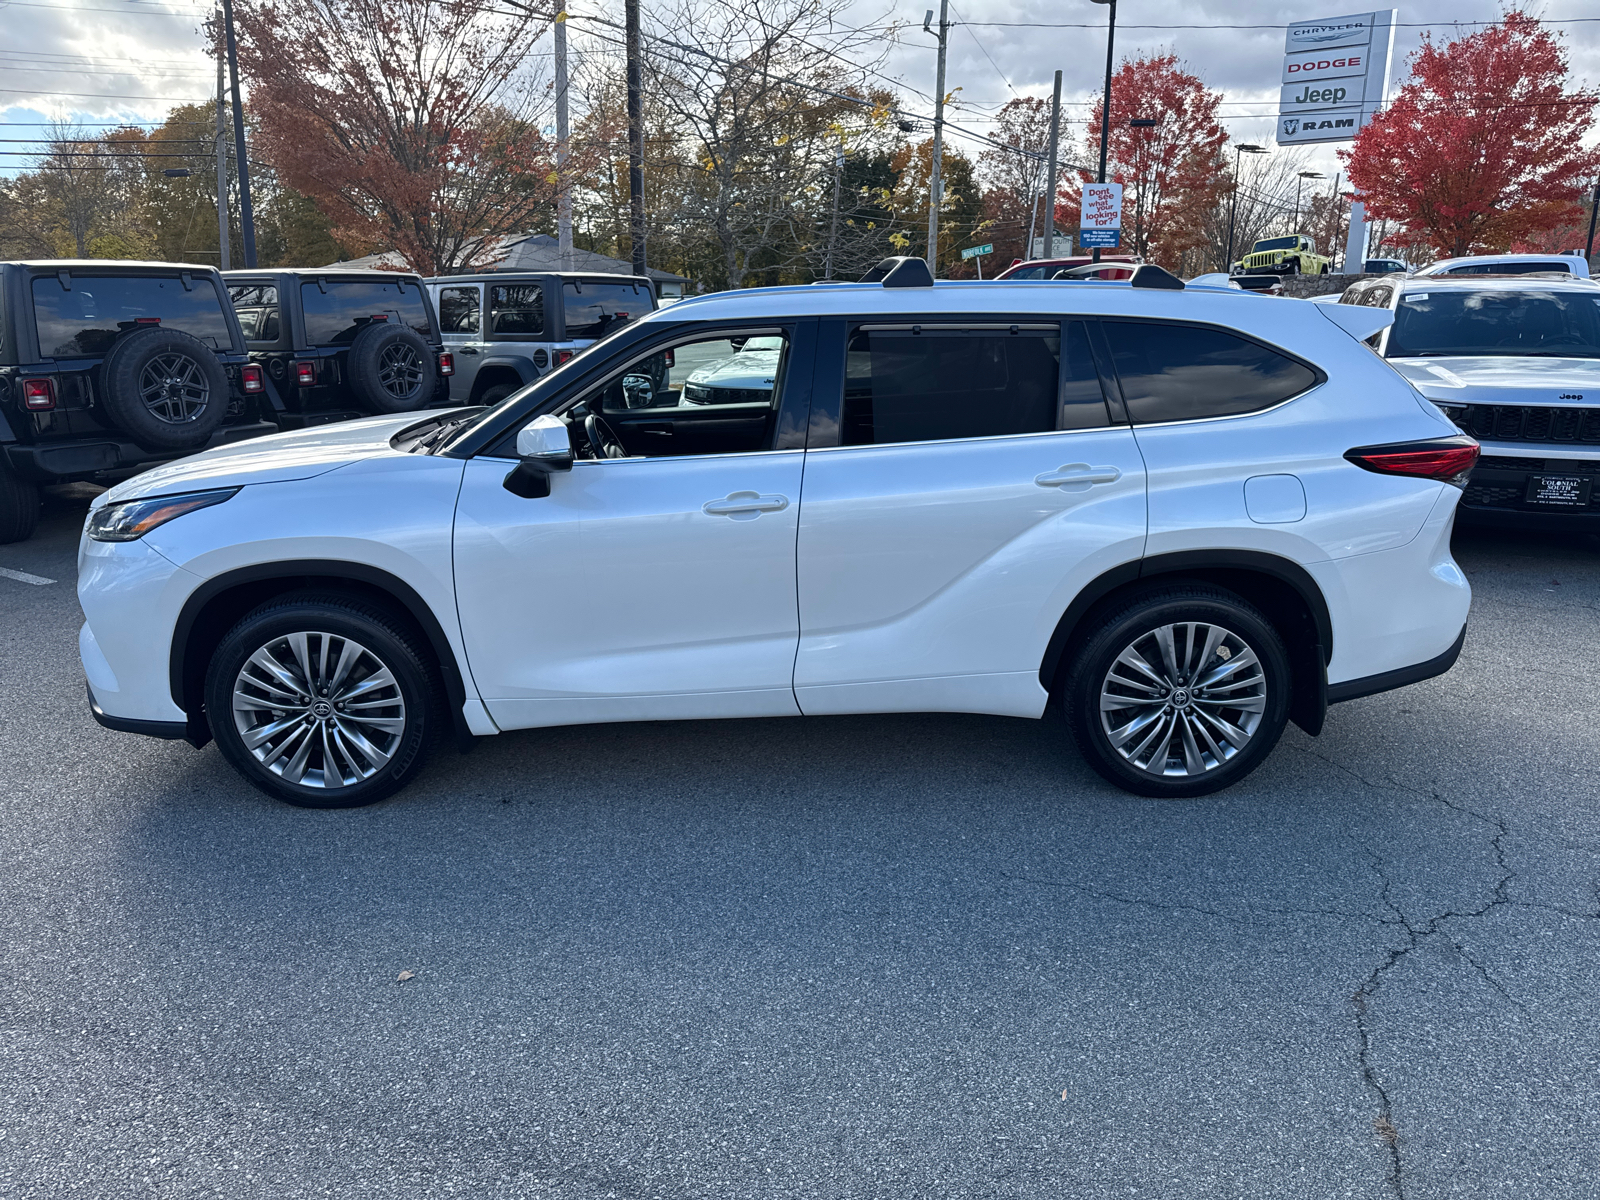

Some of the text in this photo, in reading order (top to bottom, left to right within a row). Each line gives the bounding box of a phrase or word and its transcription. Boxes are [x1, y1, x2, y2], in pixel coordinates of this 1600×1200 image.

[1293, 22, 1363, 36] CHRYSLER
[1288, 57, 1361, 73] DODGE
[1296, 86, 1346, 104] Jeep
[1302, 118, 1354, 130] RAM
[1086, 211, 1118, 220] looking
[1095, 218, 1113, 226] for?
